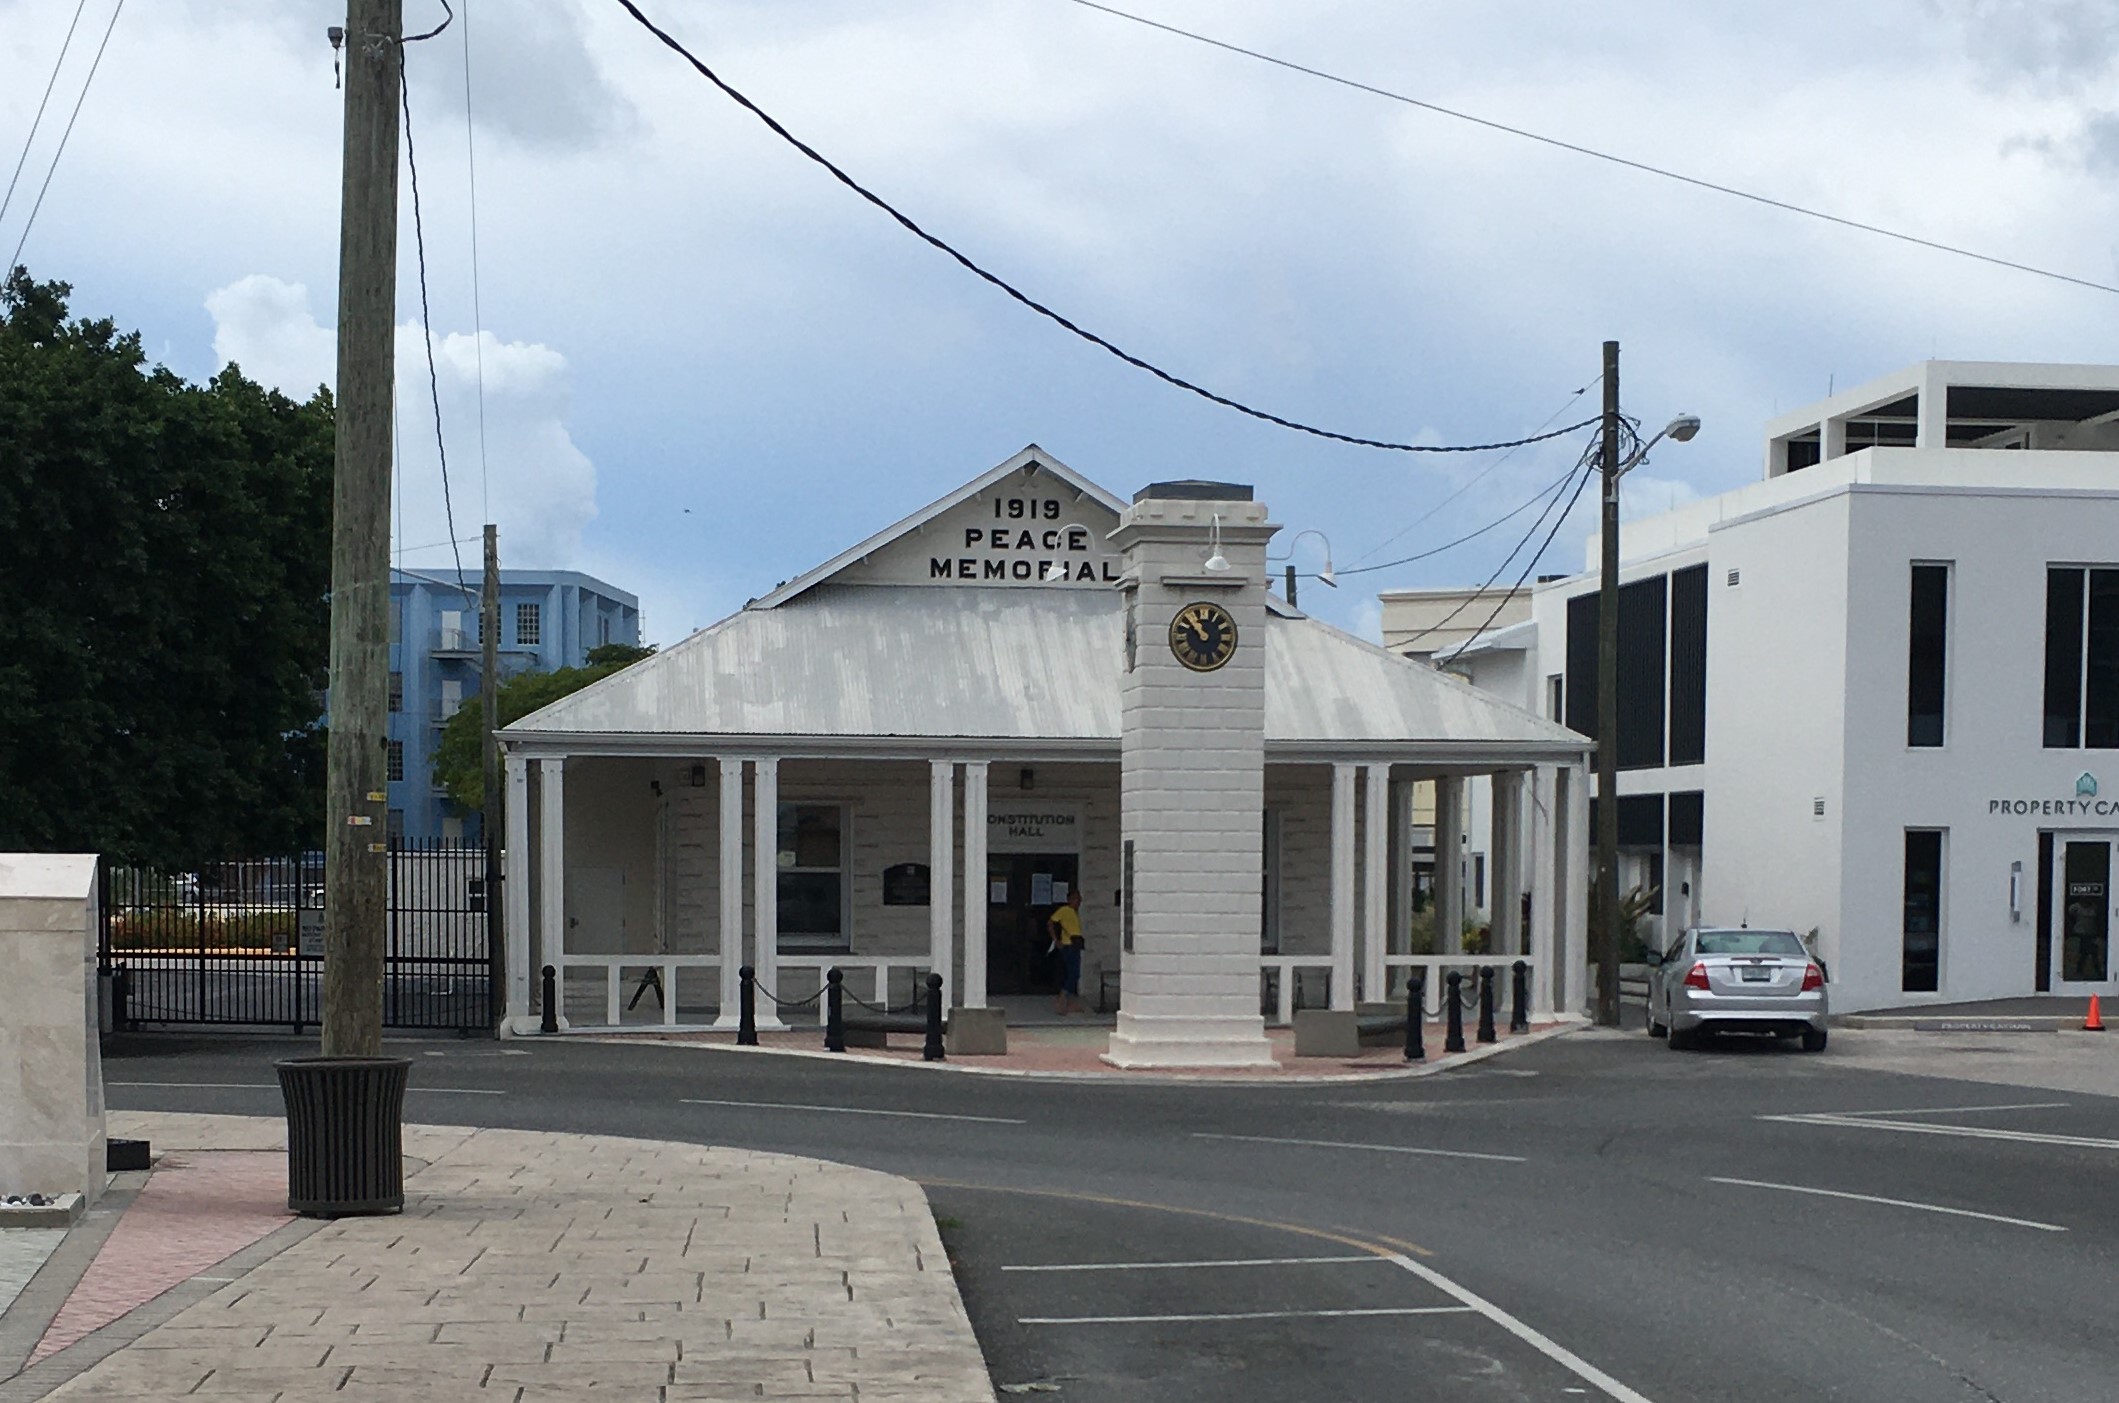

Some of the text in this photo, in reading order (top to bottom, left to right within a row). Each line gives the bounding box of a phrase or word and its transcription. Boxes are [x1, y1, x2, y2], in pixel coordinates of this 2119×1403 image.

[995, 498, 1060, 520] 1919
[965, 528, 1087, 551] PEACE
[987, 814, 1075, 825] ONSTITUTION
[1009, 827, 1044, 837] HALL
